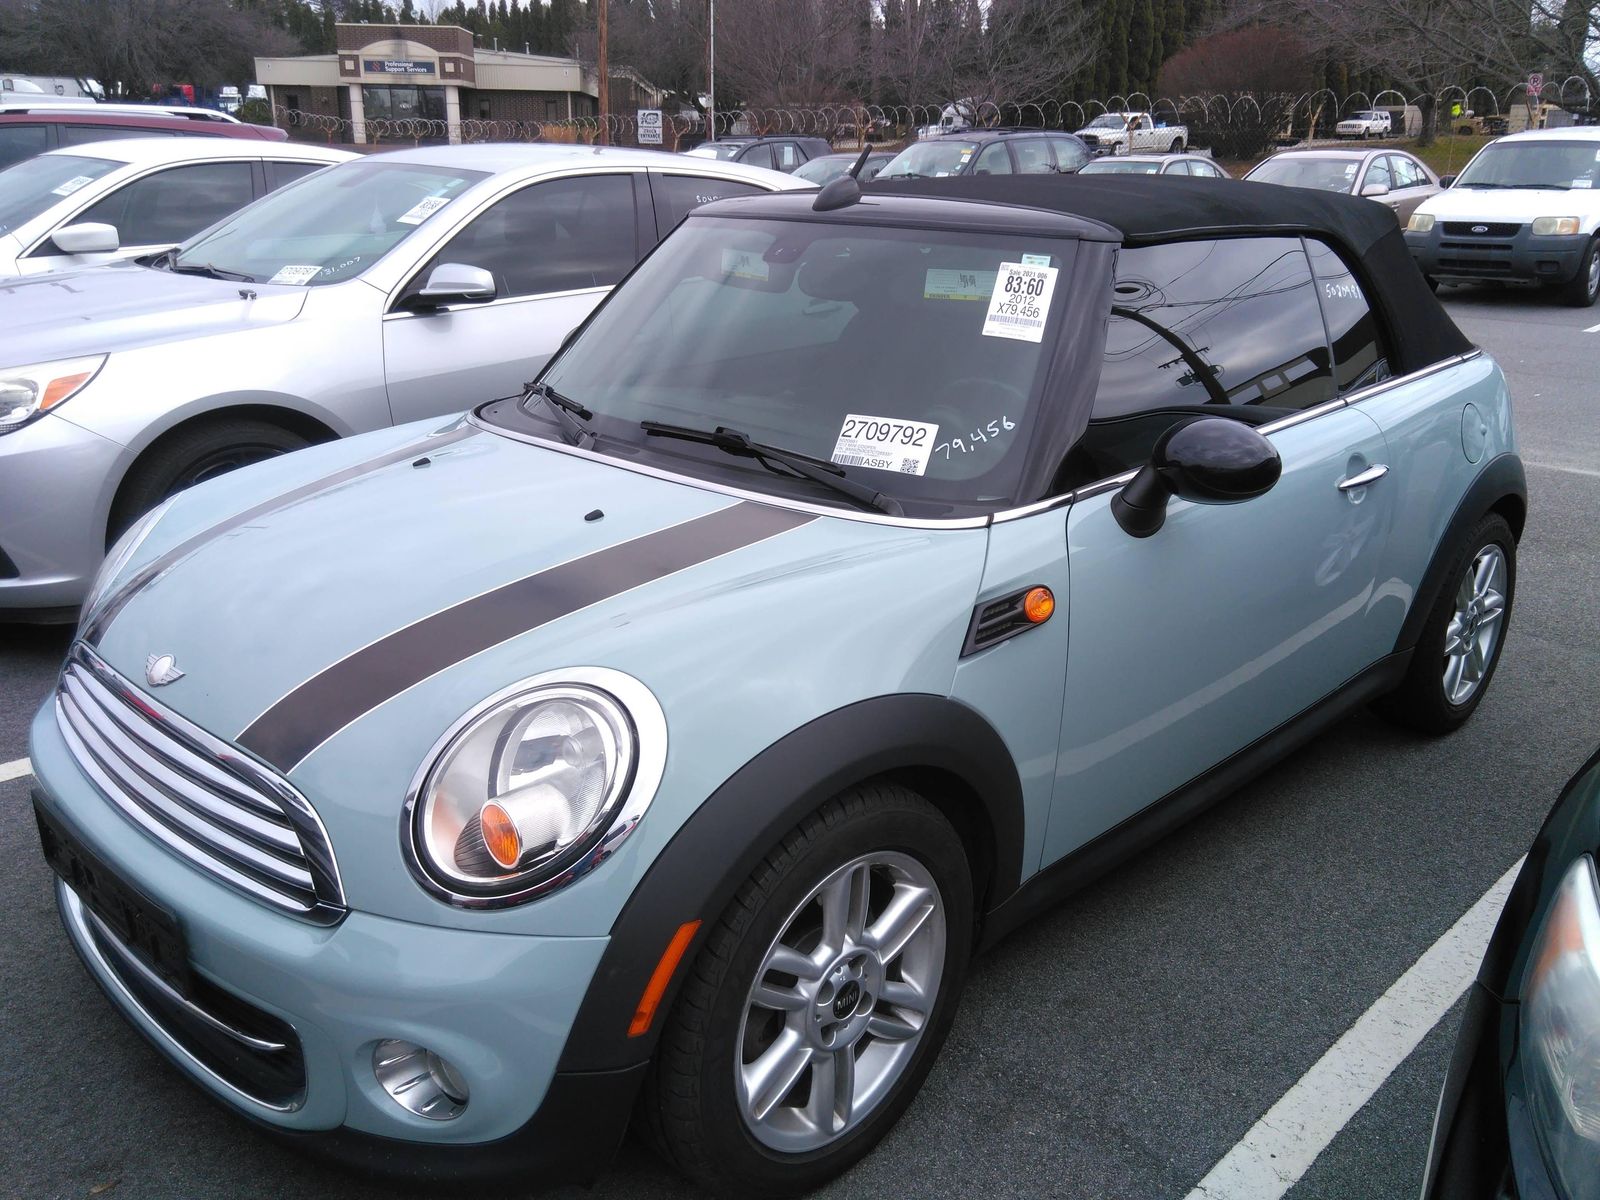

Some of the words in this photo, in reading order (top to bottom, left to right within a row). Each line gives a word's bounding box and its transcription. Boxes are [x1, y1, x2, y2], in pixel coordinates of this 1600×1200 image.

[1022, 270, 1036, 278] 2021
[1005, 275, 1044, 296] 83:60
[1008, 293, 1036, 306] 2012
[996, 302, 1041, 318] X79,456
[841, 419, 927, 447] 2709792
[862, 458, 893, 468] ASBY
[837, 991, 857, 1010] MINI
